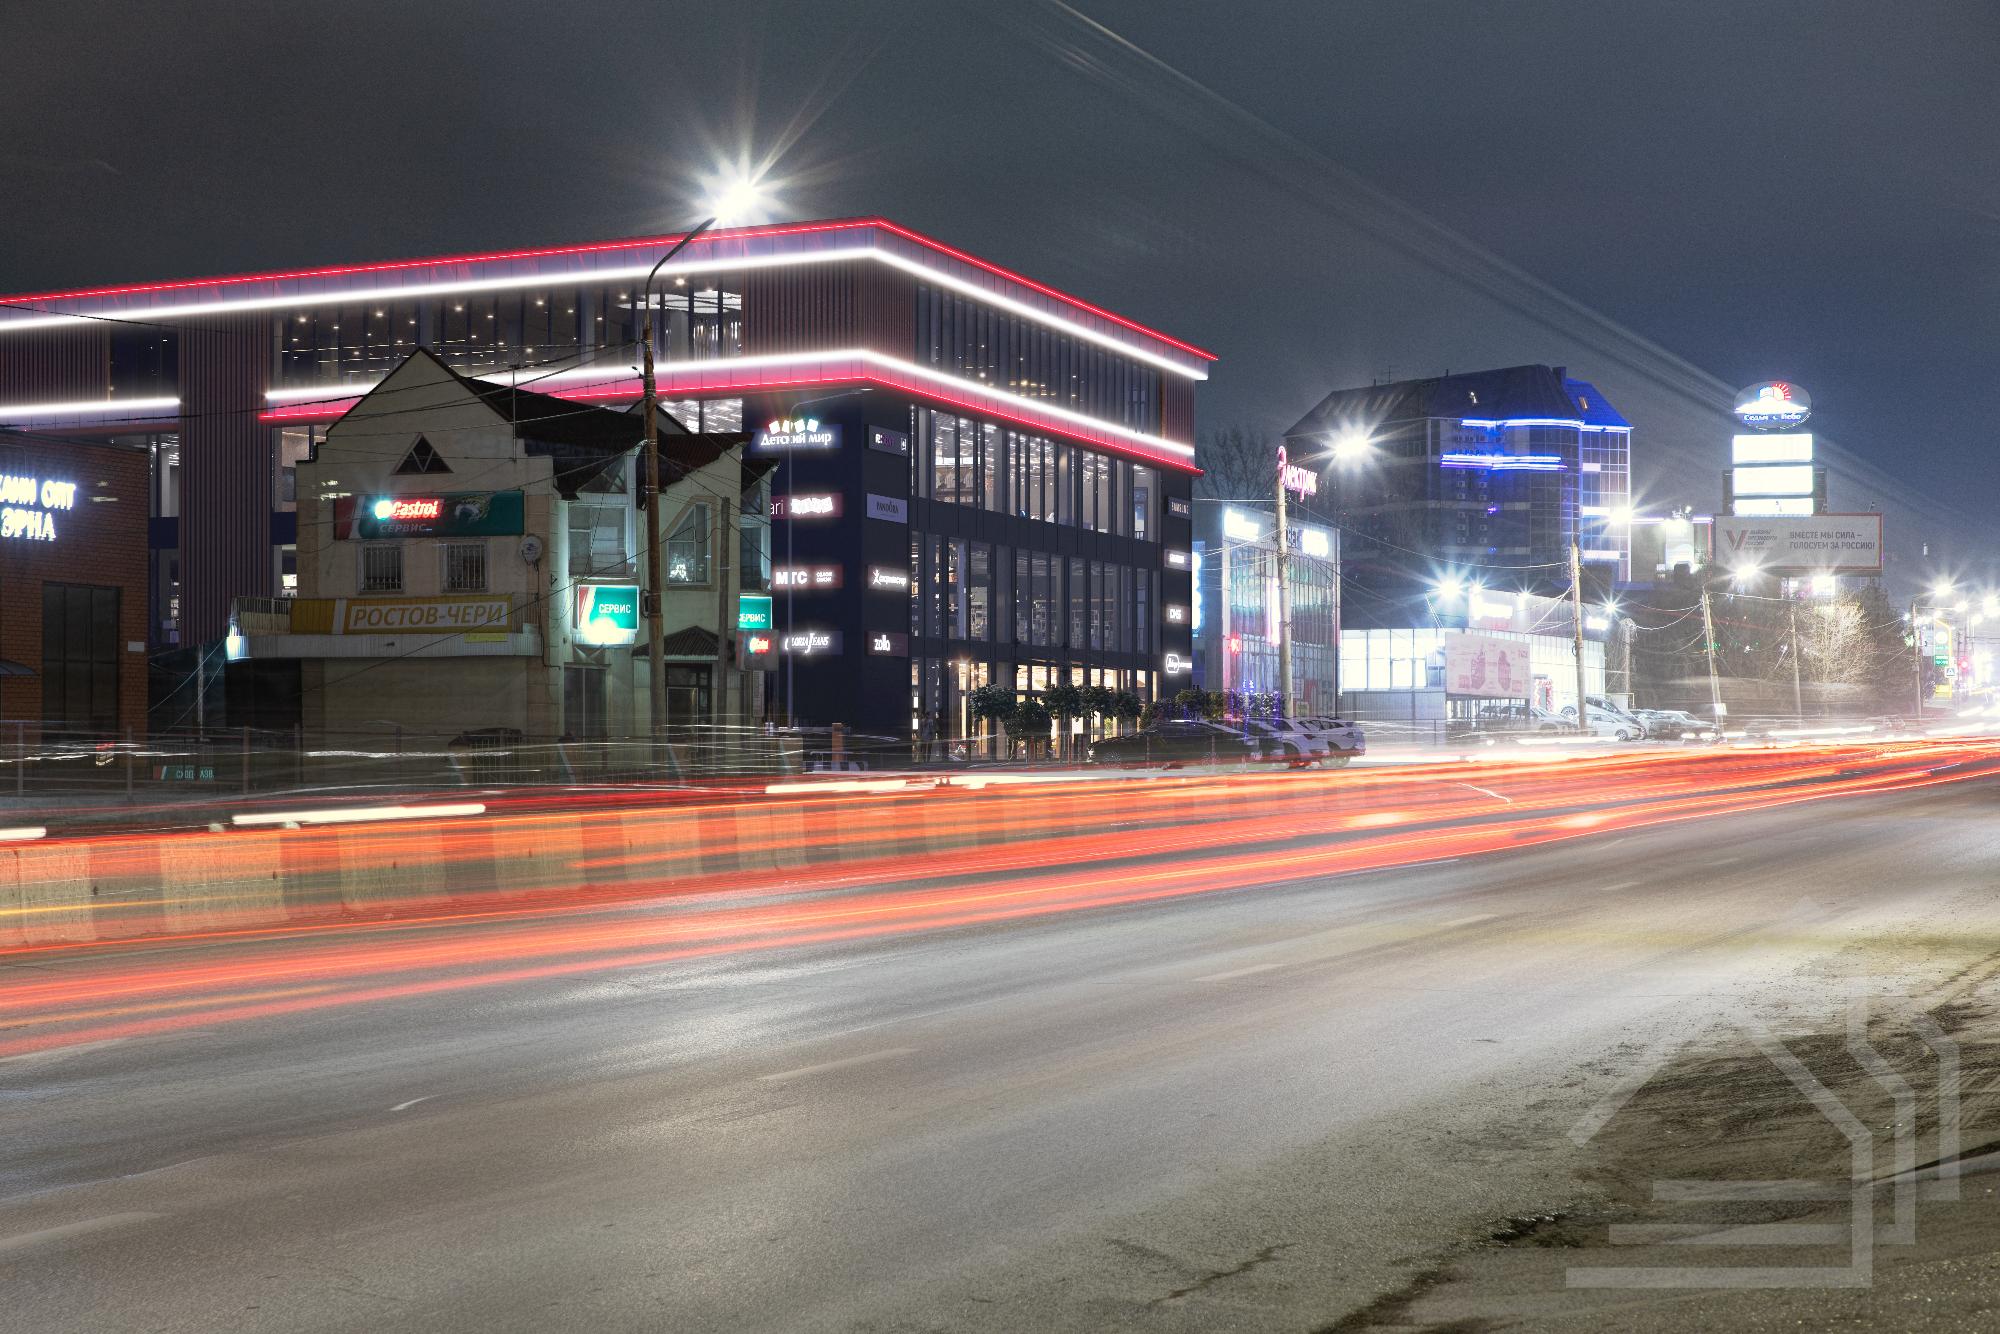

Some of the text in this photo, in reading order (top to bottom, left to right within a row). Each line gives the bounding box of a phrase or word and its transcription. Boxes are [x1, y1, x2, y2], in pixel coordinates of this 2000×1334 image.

[808, 433, 832, 446] мир
[770, 499, 784, 515] ari
[379, 523, 427, 533] СЕРВИС
[1789, 531, 1819, 540] ВМЕСТЕ
[1820, 532, 1834, 540] МЫ
[1835, 532, 1856, 540] СИЛА
[1789, 541, 1876, 550] ГОЛОСУЕМ ЗА РОССИЮ!
[598, 603, 632, 614] СЕРВИС
[353, 604, 504, 626] РОСТОВ-ЧЕРИ
